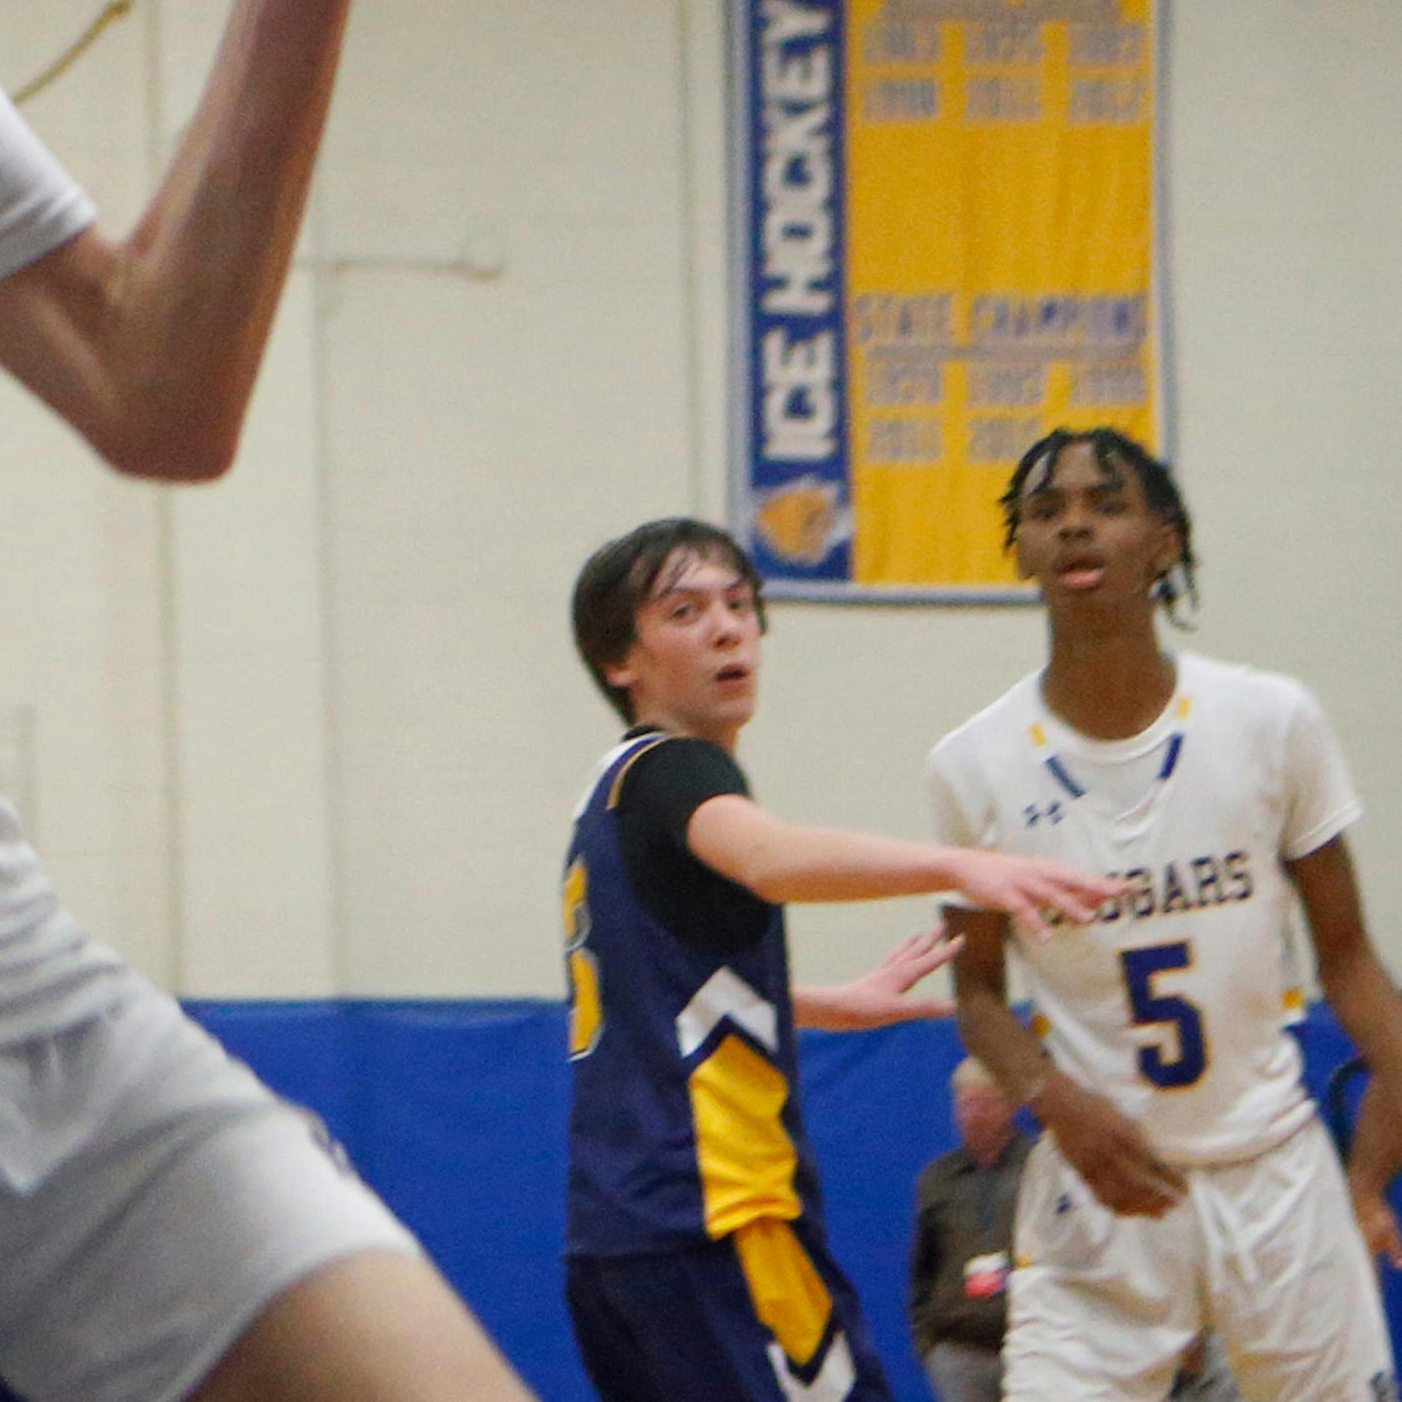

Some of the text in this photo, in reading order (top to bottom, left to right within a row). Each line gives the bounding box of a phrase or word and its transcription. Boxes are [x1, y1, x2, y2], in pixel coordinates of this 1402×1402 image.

[852, 293, 953, 342] STATE
[761, 326, 836, 462] ICE
[1118, 937, 1208, 1092] 5
